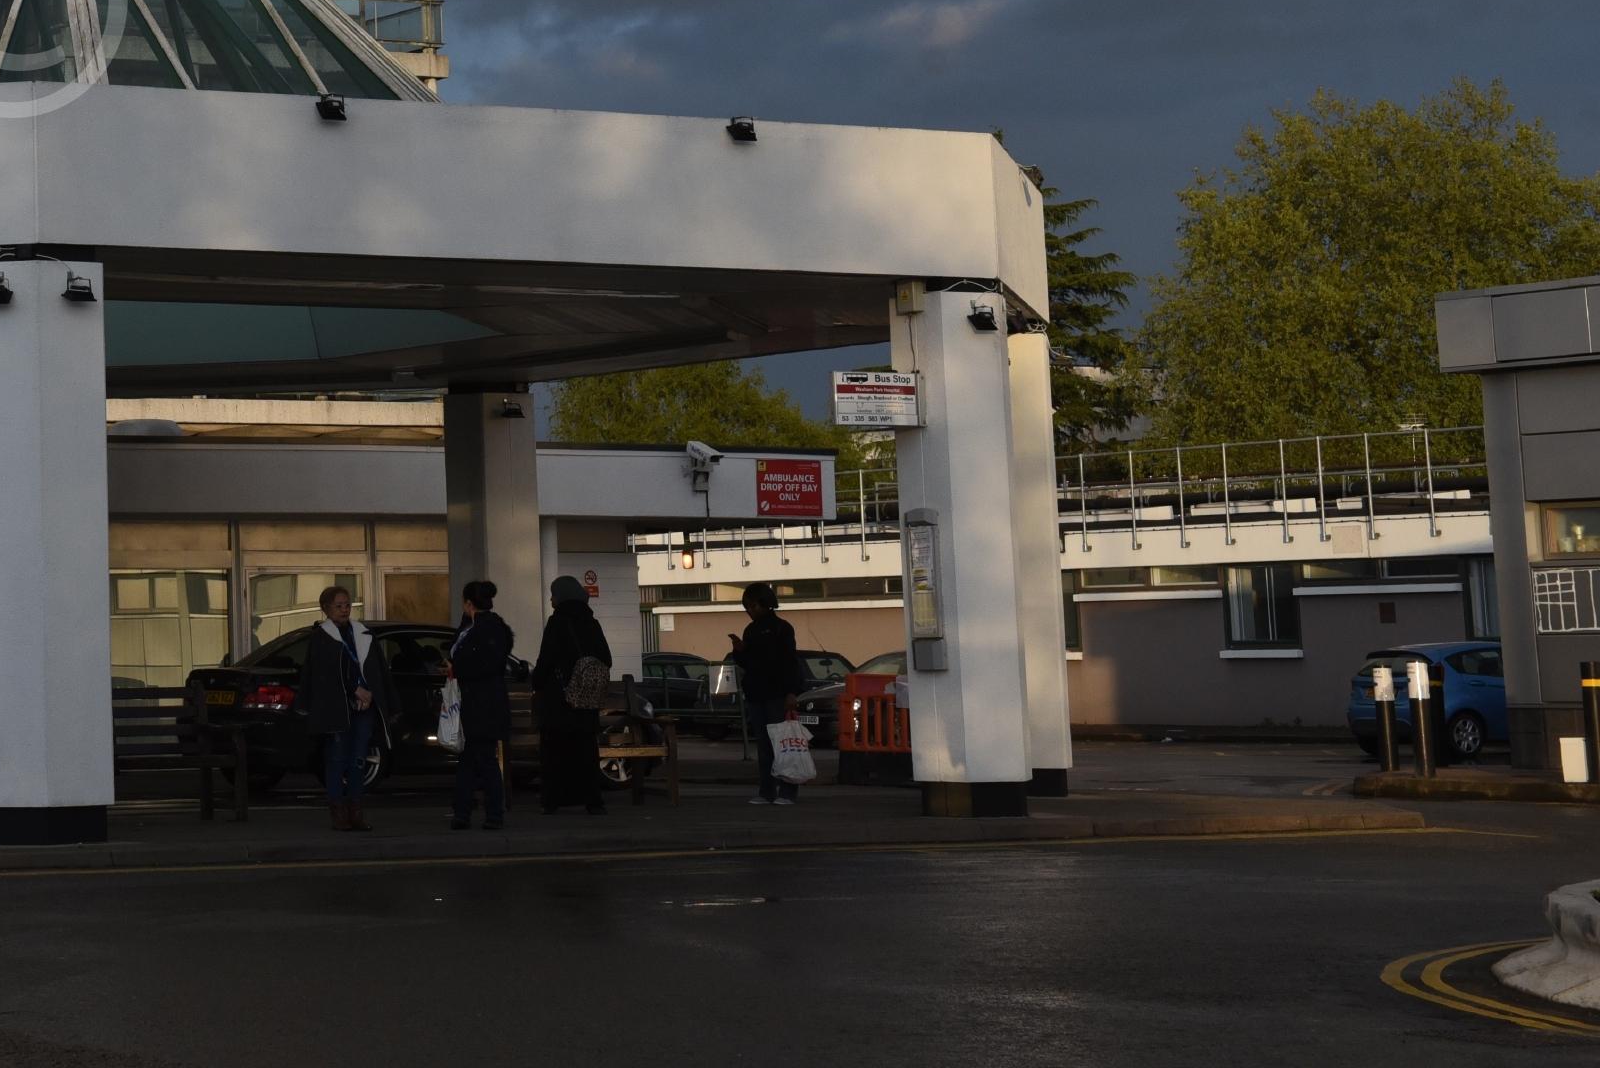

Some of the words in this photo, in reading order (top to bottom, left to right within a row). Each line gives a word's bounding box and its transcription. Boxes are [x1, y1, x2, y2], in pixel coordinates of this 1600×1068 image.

[874, 374, 890, 383] Bus
[893, 375, 911, 385] Stop
[763, 473, 816, 483] AMBULANCE
[760, 483, 783, 492] DROP
[784, 483, 801, 492] OFF
[801, 484, 818, 493] BAY
[778, 492, 801, 501] ONLY
[780, 738, 808, 748] TESC
